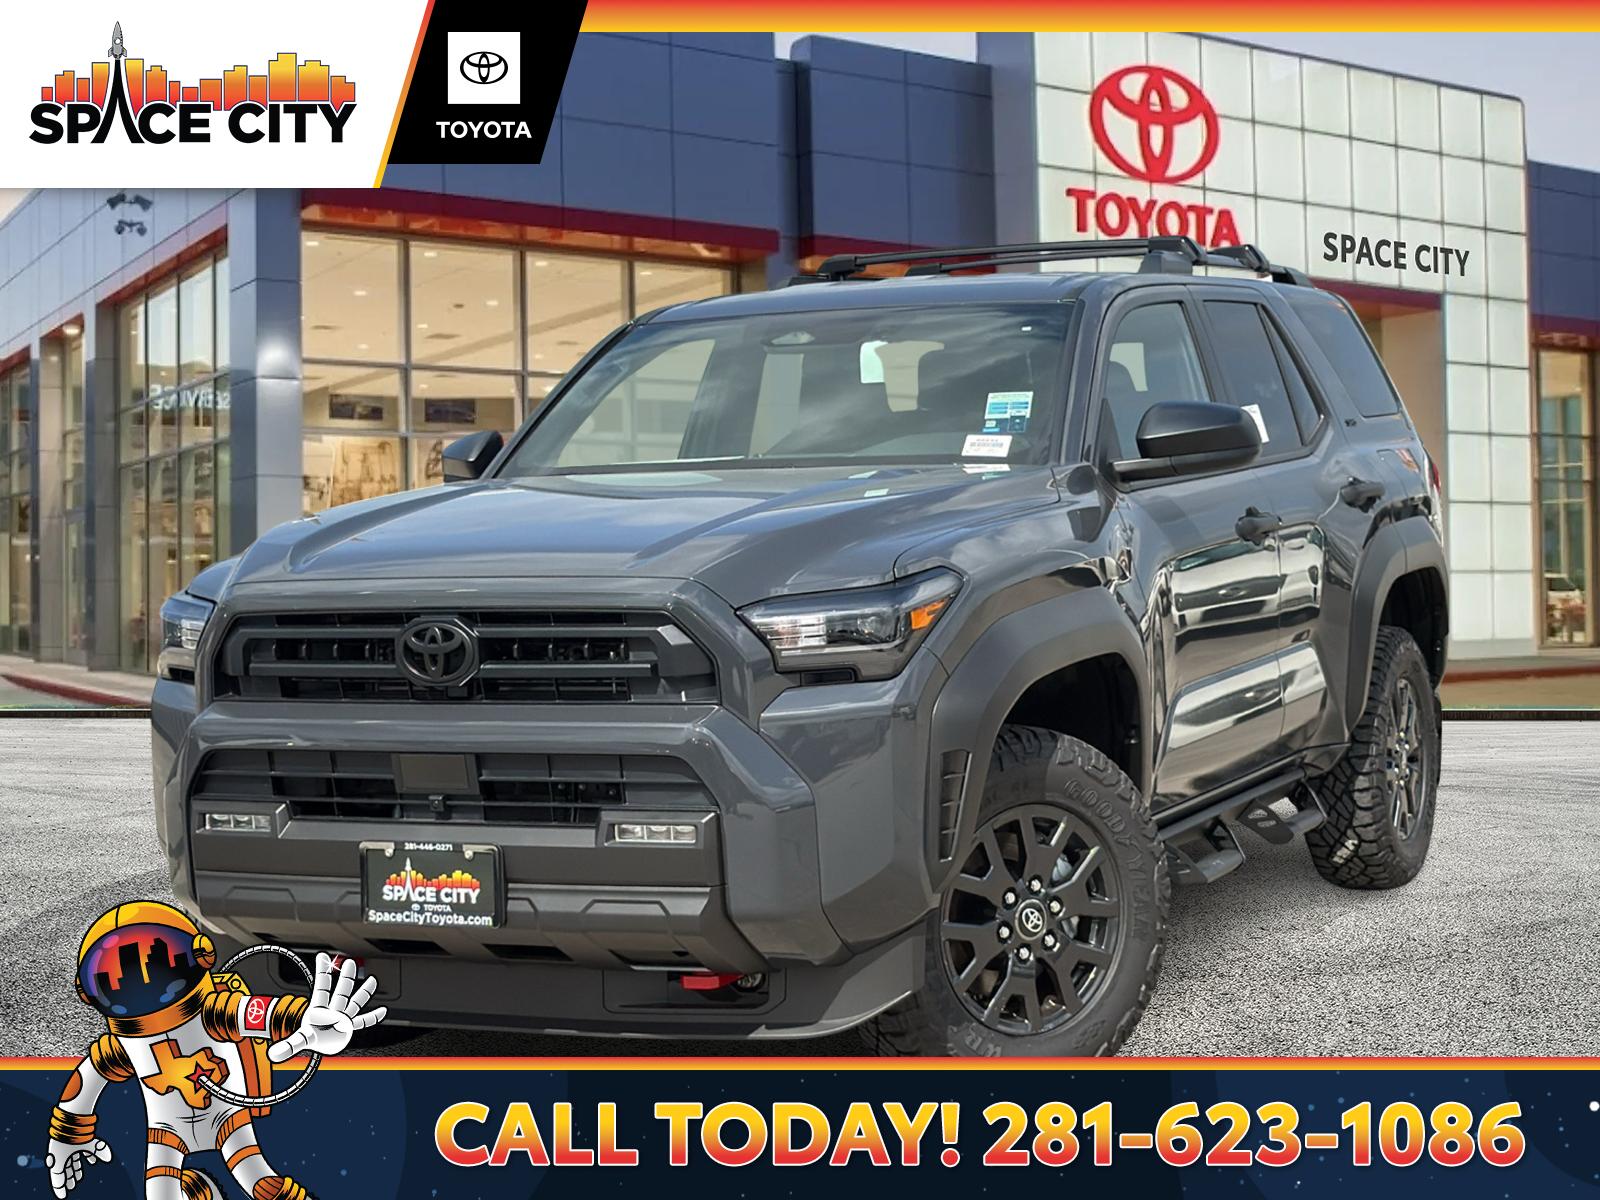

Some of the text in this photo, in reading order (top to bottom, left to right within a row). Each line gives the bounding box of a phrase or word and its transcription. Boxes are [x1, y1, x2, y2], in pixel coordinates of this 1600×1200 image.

[1065, 187, 1242, 249] TOYOTA
[1322, 231, 1471, 278] SPACE CITY
[404, 842, 453, 851] 281-446-0271
[382, 883, 480, 904] SPACE CITY
[368, 909, 493, 926] SpaceCityToyota.com
[424, 904, 452, 912] TOYOTA
